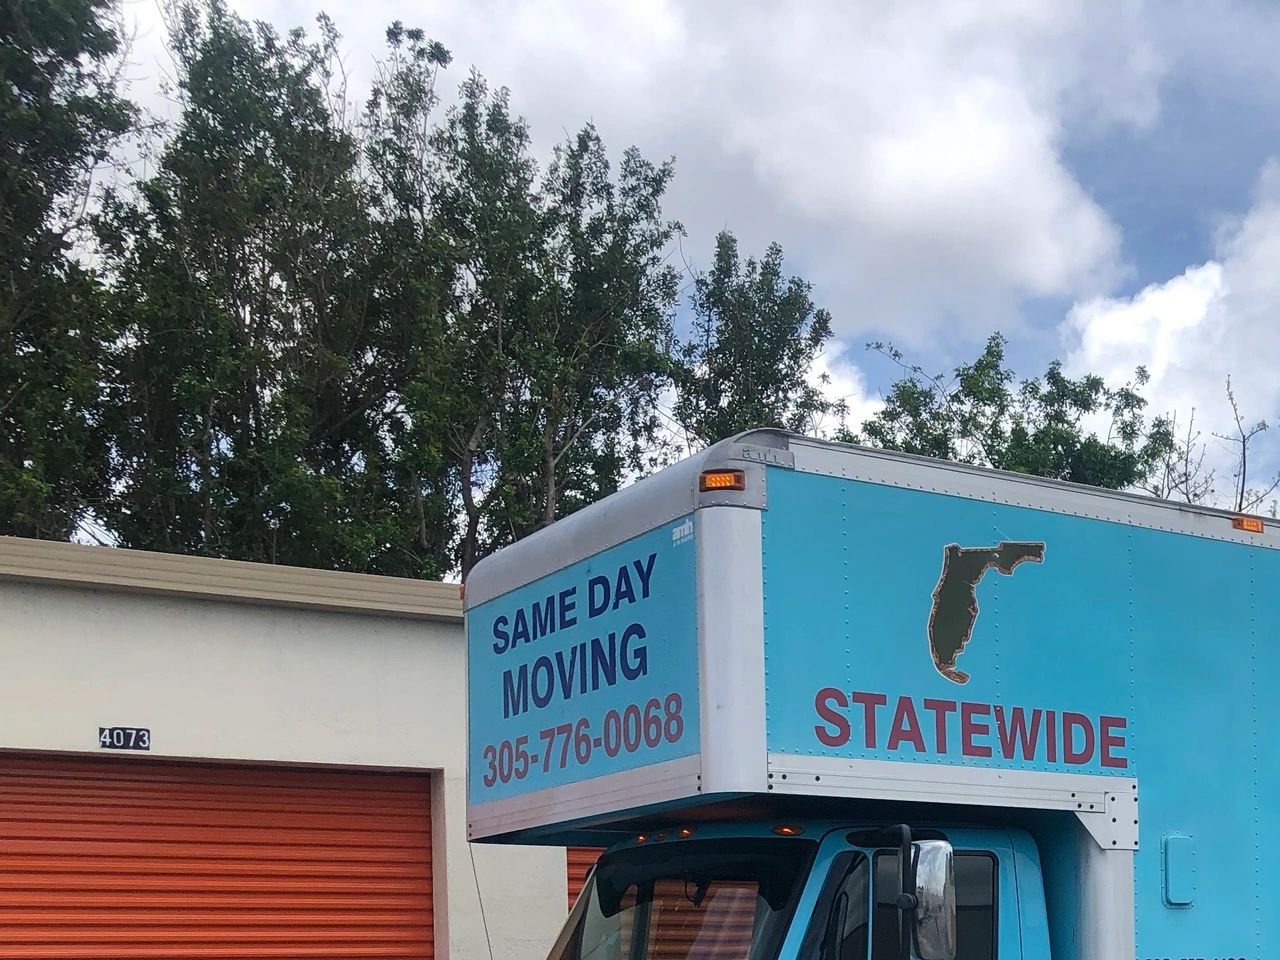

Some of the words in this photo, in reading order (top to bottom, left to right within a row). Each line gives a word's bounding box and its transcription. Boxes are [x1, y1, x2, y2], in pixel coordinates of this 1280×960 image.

[492, 586, 577, 655] SAME
[588, 552, 658, 619] DAY
[503, 622, 648, 719] MOVING
[100, 728, 149, 747] 4073
[483, 692, 684, 788] 305-776-0068
[814, 687, 1128, 769] STATEWIDE
